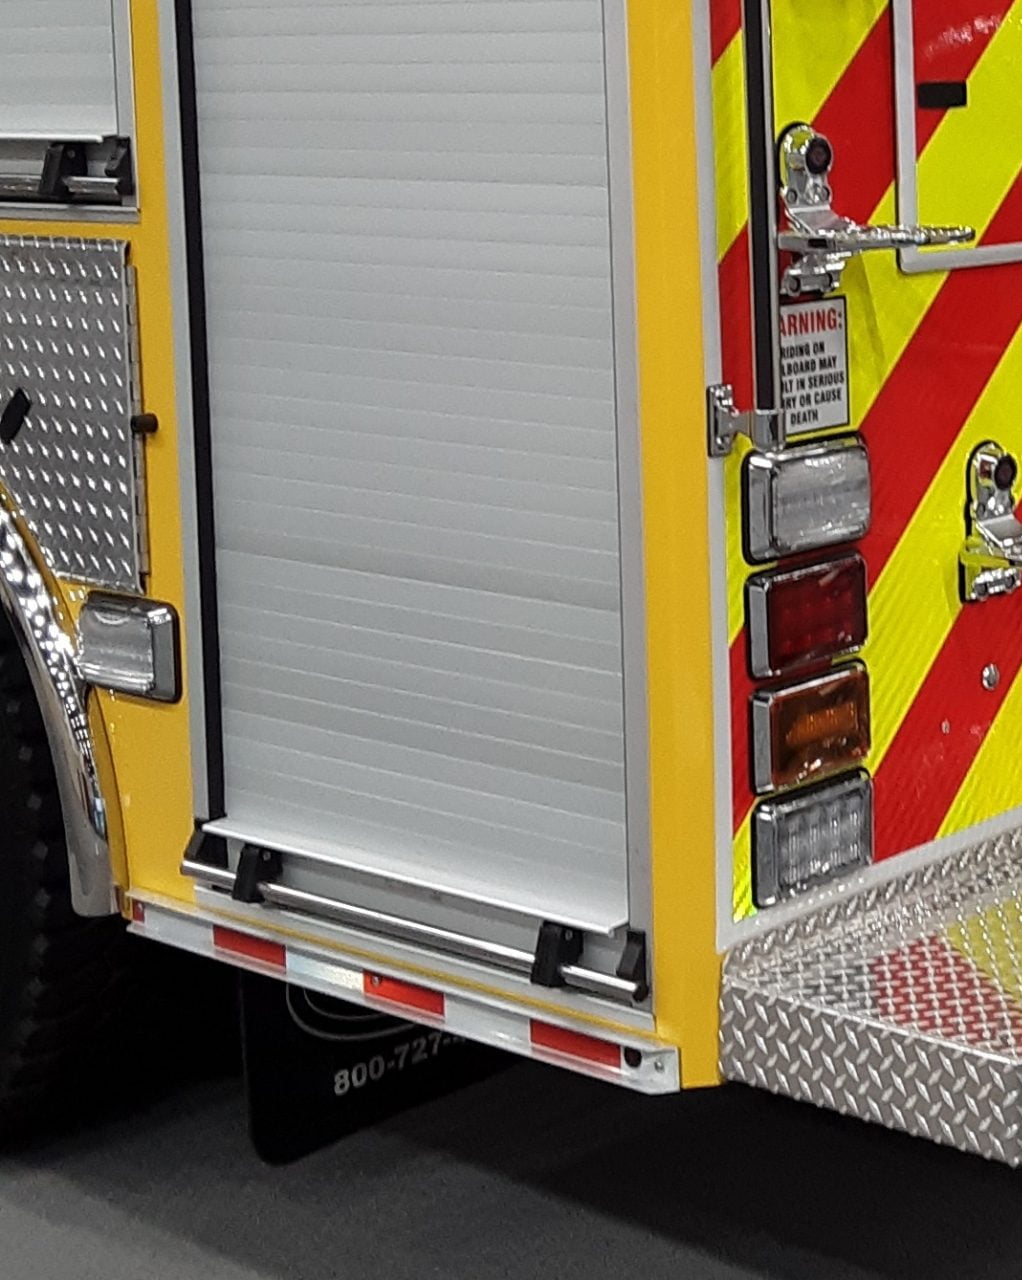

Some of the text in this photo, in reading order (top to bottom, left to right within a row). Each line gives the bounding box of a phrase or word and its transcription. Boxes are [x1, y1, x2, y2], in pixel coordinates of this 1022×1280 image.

[780, 308, 843, 337] ARNING:
[813, 341, 825, 355] ON
[819, 356, 837, 370] MAY
[796, 378, 806, 392] IN
[808, 371, 845, 389] SERIOUS
[799, 393, 812, 407] OR
[814, 387, 842, 404] CAUSE
[790, 409, 819, 426] DEATH
